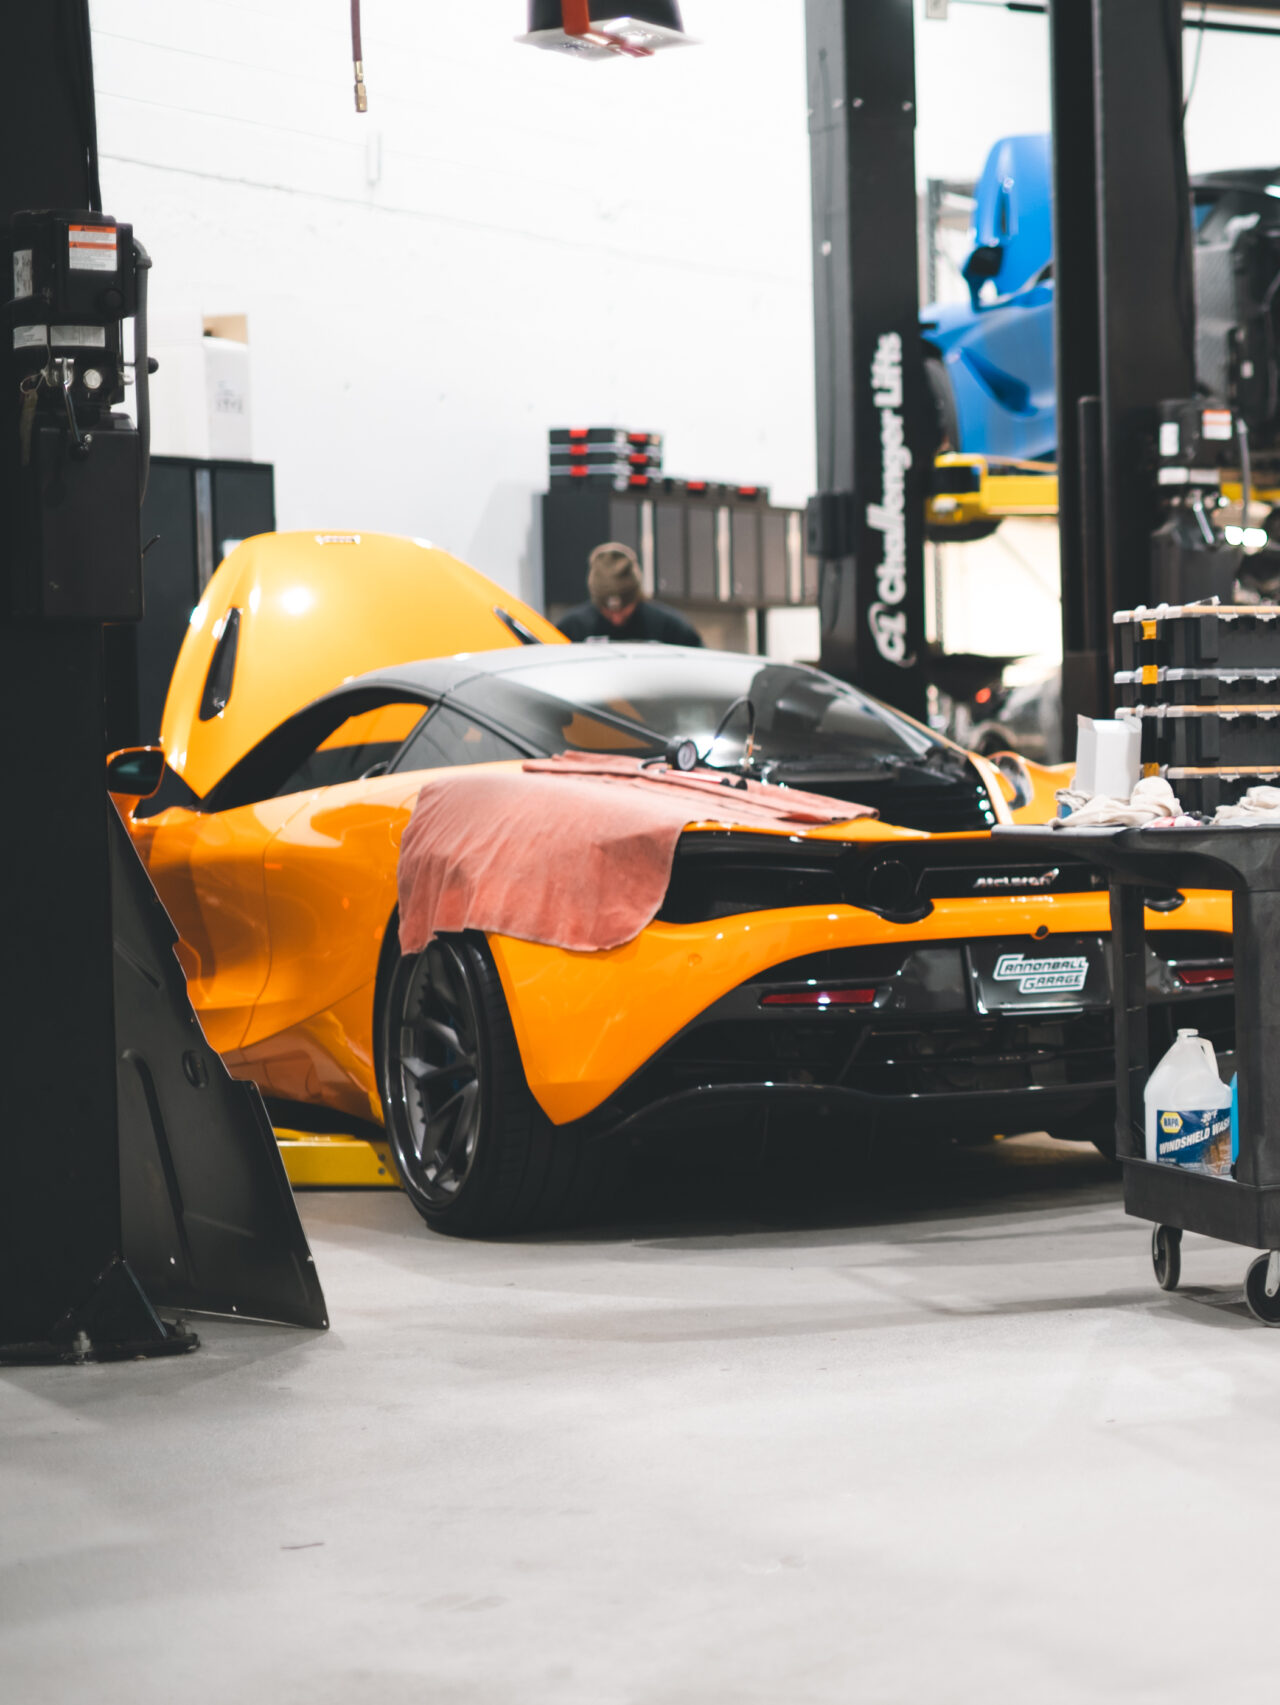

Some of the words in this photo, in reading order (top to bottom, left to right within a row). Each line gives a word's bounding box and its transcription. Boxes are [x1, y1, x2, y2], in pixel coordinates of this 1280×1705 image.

[871, 332, 902, 408] Lifts
[867, 408, 912, 605] Challenger
[996, 957, 1086, 977] CANNONBALL
[1022, 976, 1082, 990] GARAGE
[1163, 1118, 1180, 1128] NAPA
[1159, 1127, 1210, 1155] WINDSHIELD
